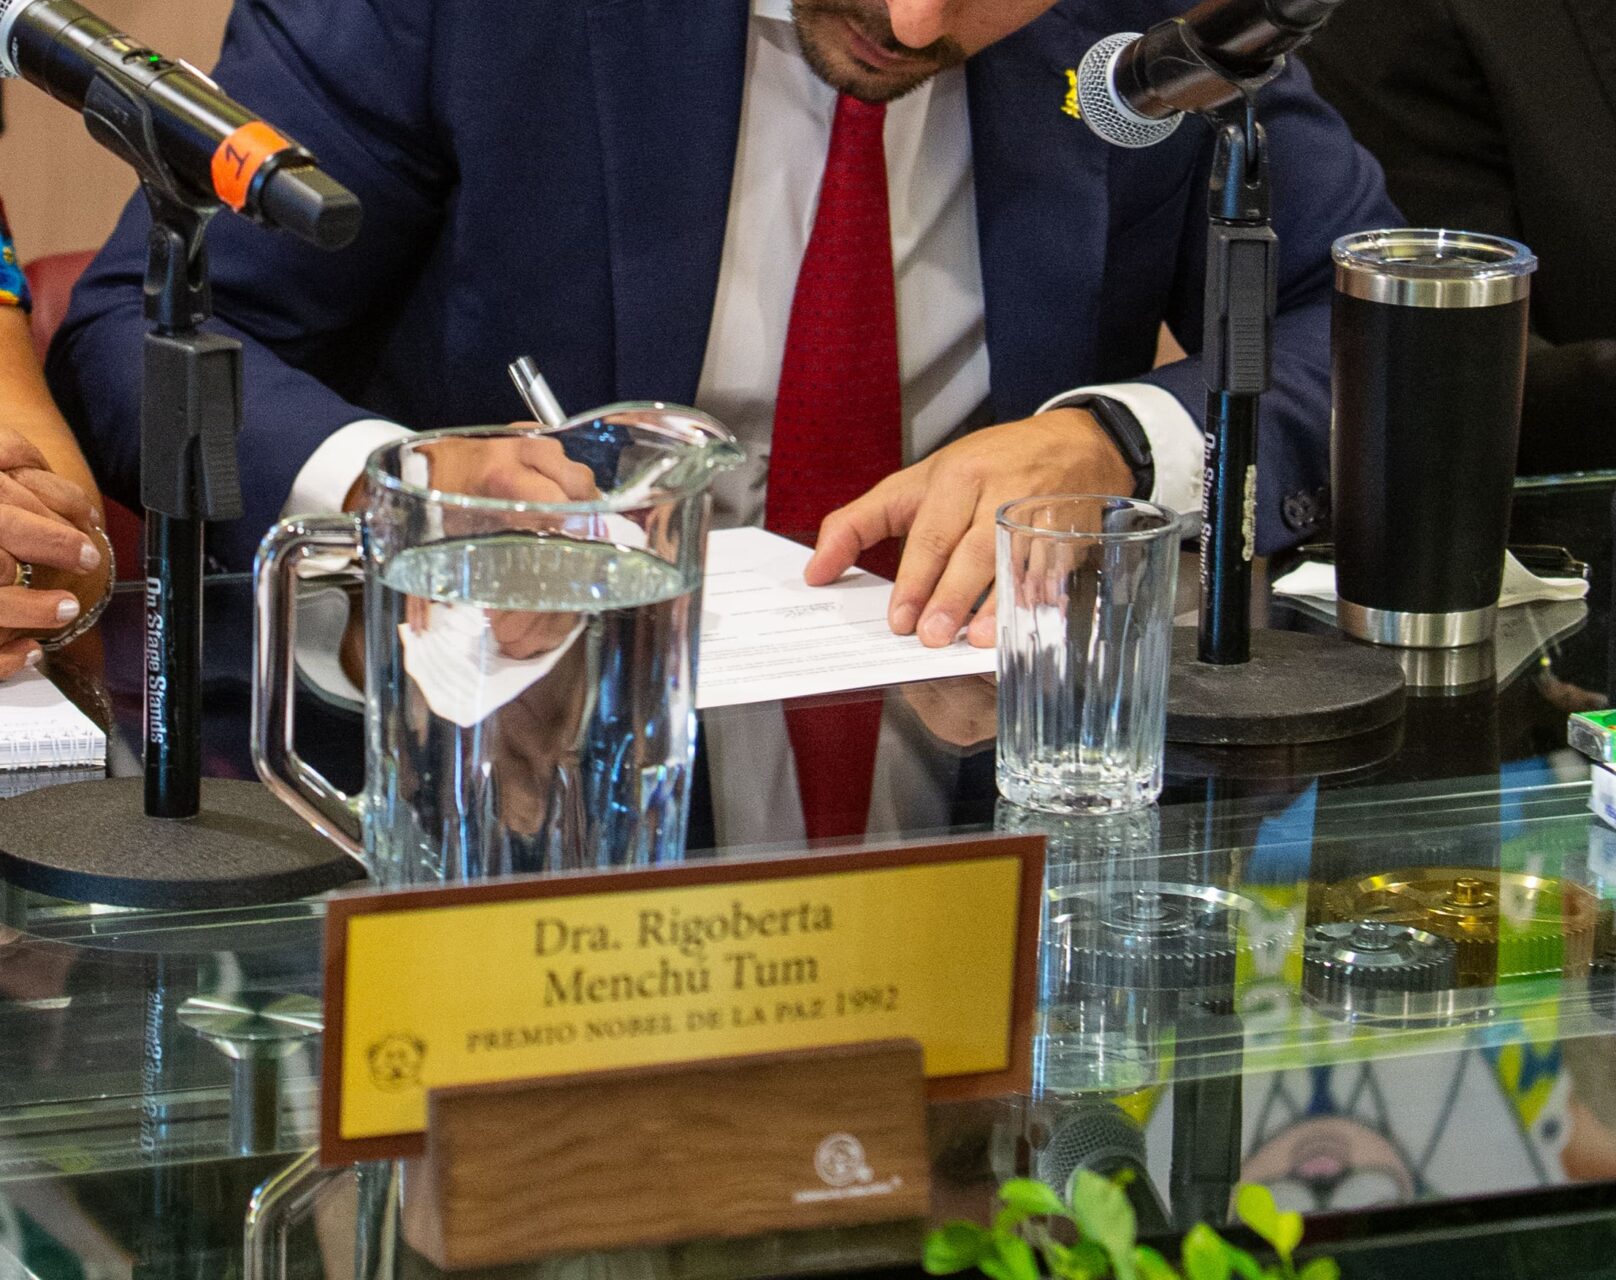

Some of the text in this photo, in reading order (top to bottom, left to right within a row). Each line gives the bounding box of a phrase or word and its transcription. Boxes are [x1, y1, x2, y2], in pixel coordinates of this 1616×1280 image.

[226, 143, 250, 180] 1
[147, 576, 167, 744] On Stage Stands
[532, 898, 834, 958] Dra. Rigoberta
[723, 951, 819, 992] Tum
[465, 984, 899, 1054] PREMIO NOBEL DE LA PAZ 1992
